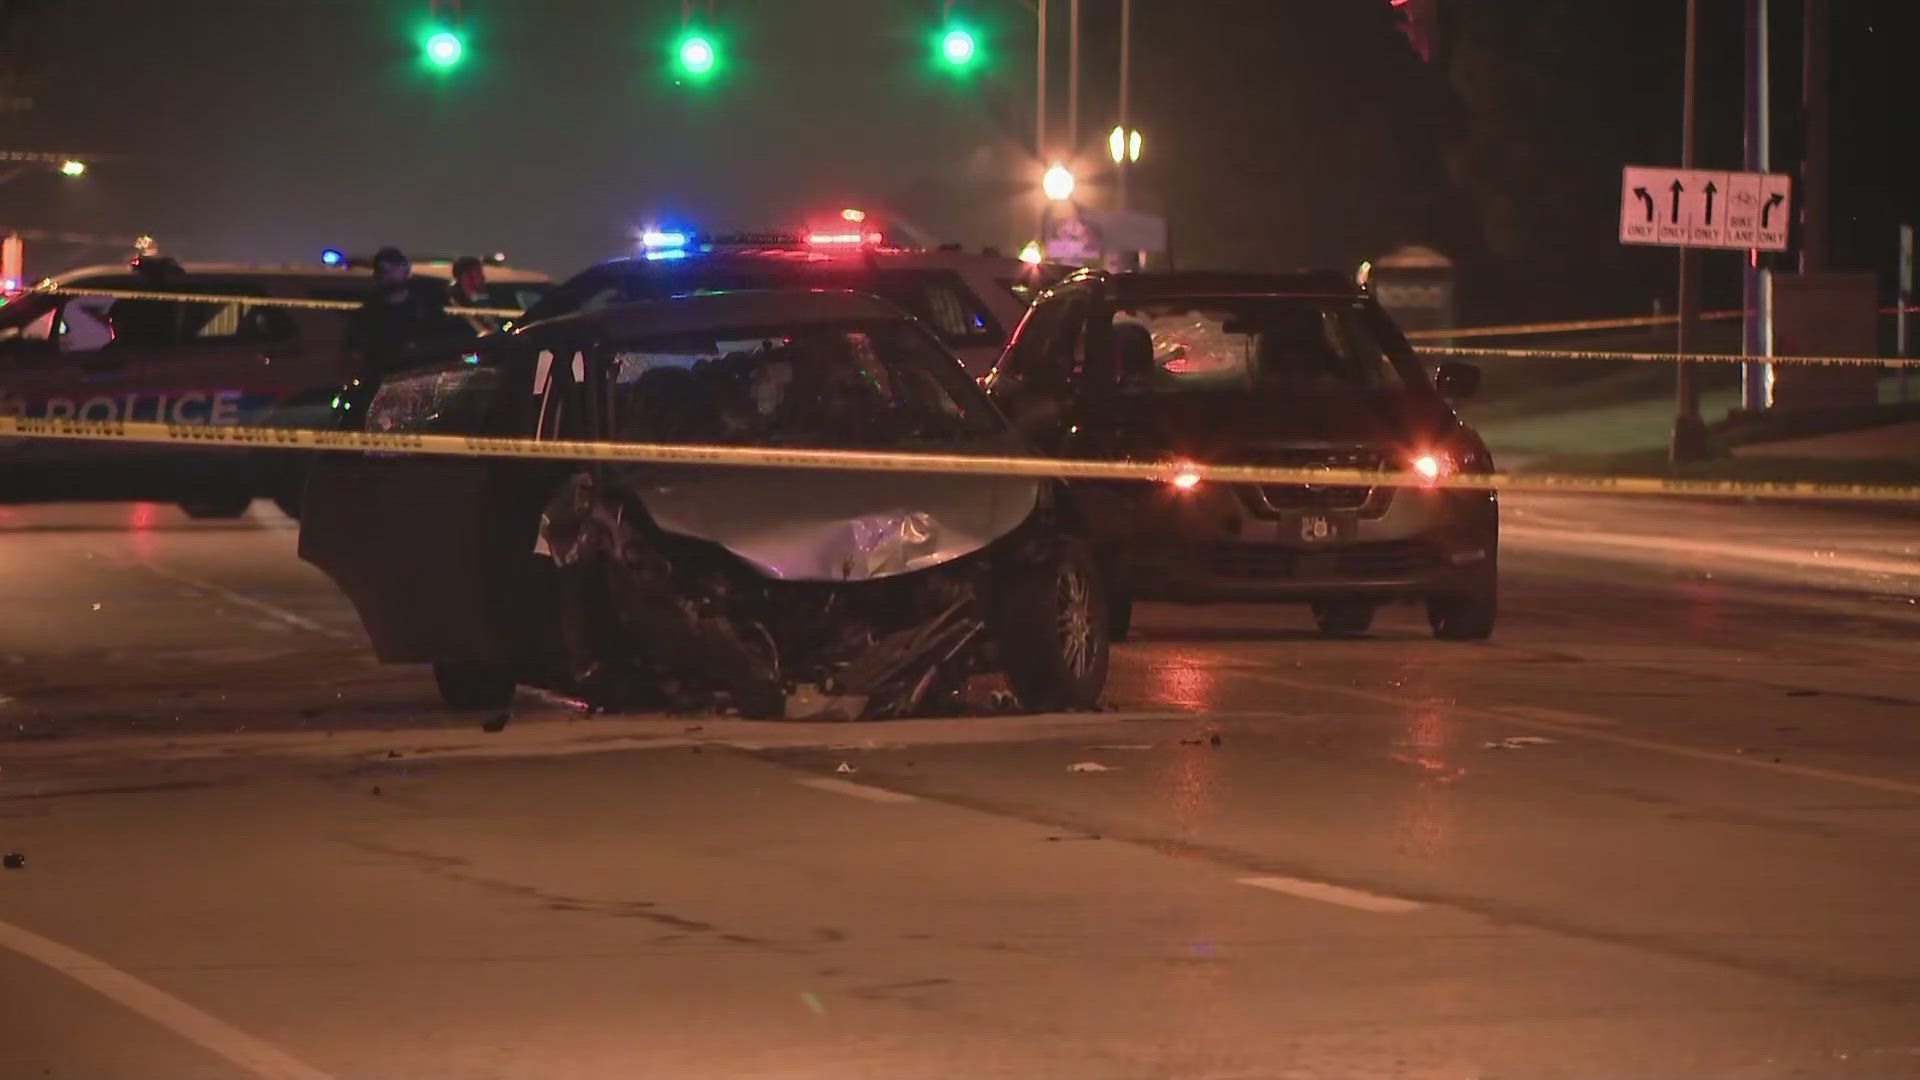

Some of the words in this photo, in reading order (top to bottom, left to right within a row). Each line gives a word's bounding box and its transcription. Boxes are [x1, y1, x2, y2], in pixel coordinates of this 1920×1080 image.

[1730, 216, 1752, 227] BIKE
[1627, 226, 1652, 236] ONLY
[1660, 226, 1686, 238] ONLY
[1695, 228, 1719, 240] ONLY
[1728, 230, 1755, 241] LANE
[1758, 231, 1784, 243] ONLY
[45, 390, 242, 424] POLICE
